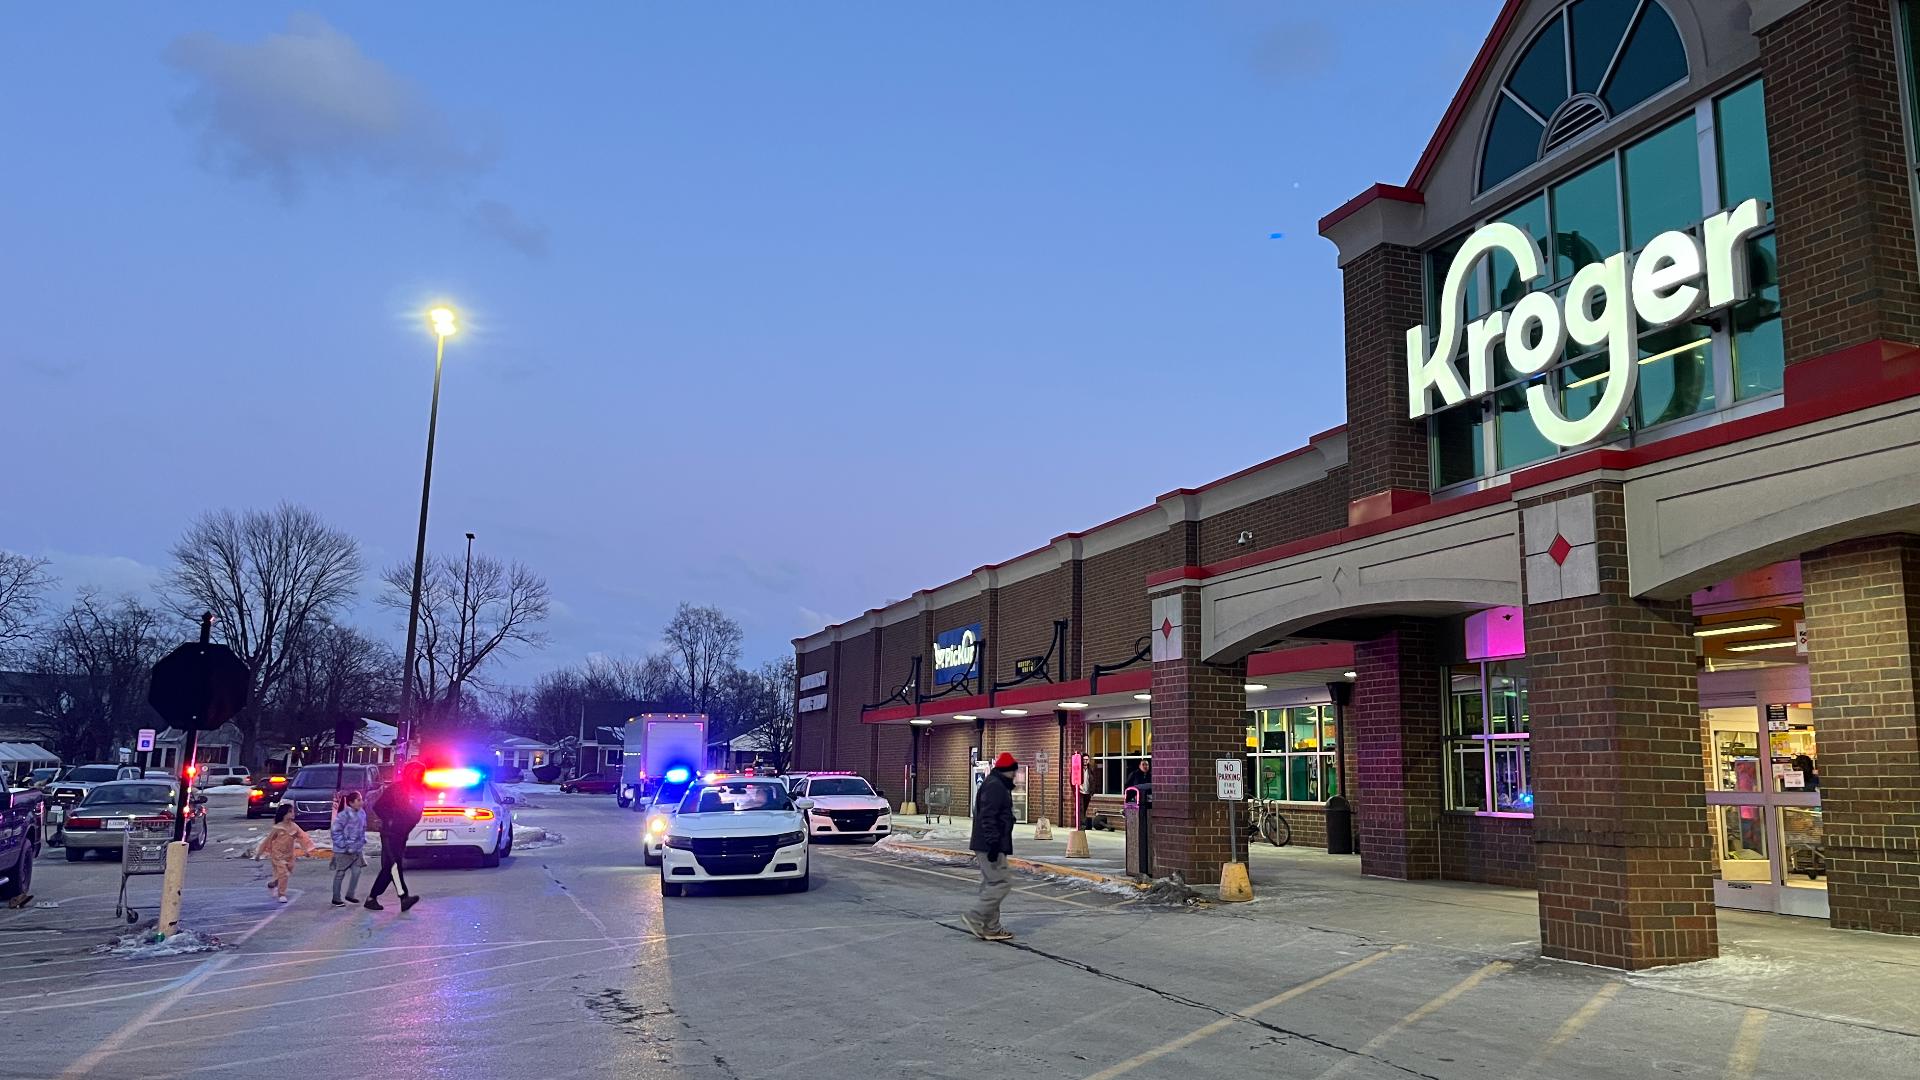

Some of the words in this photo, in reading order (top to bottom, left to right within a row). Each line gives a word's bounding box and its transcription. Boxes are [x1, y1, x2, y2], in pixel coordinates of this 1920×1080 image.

[1406, 198, 1766, 446] Kroger
[1224, 763, 1234, 771] NO
[1218, 773, 1241, 781] PARKING
